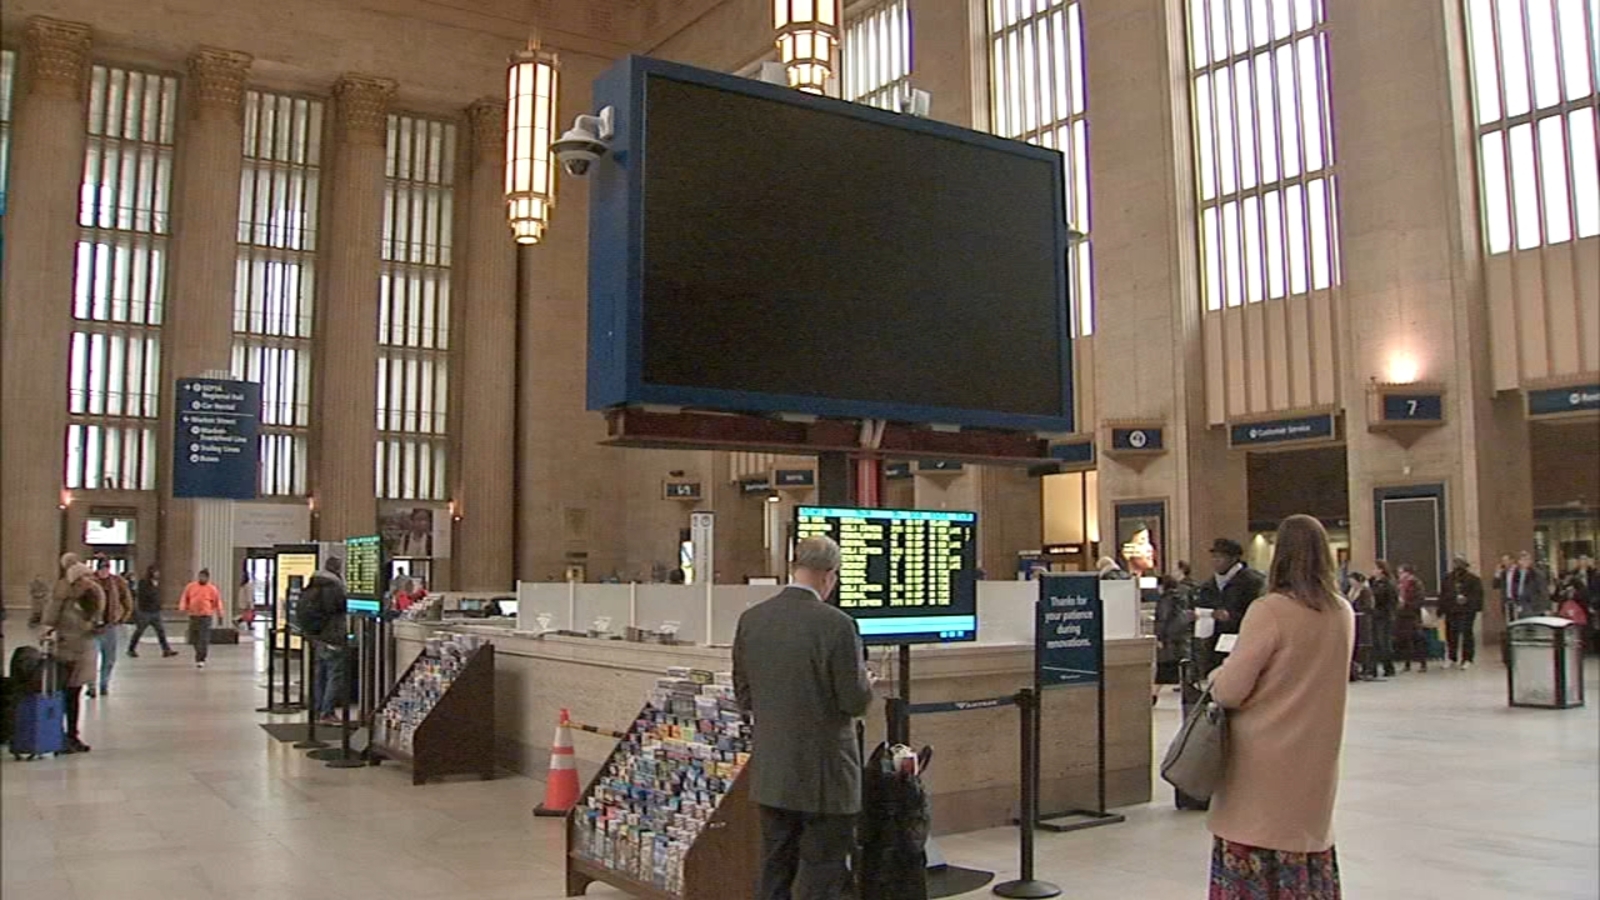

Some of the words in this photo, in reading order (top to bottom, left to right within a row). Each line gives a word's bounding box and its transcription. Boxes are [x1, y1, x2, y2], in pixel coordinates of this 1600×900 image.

[1406, 400, 1417, 415] 7
[1050, 595, 1076, 606] Thanks
[1077, 595, 1088, 605] for
[1045, 612, 1062, 624] your
[1063, 610, 1094, 622] patience
[1056, 624, 1081, 635] during
